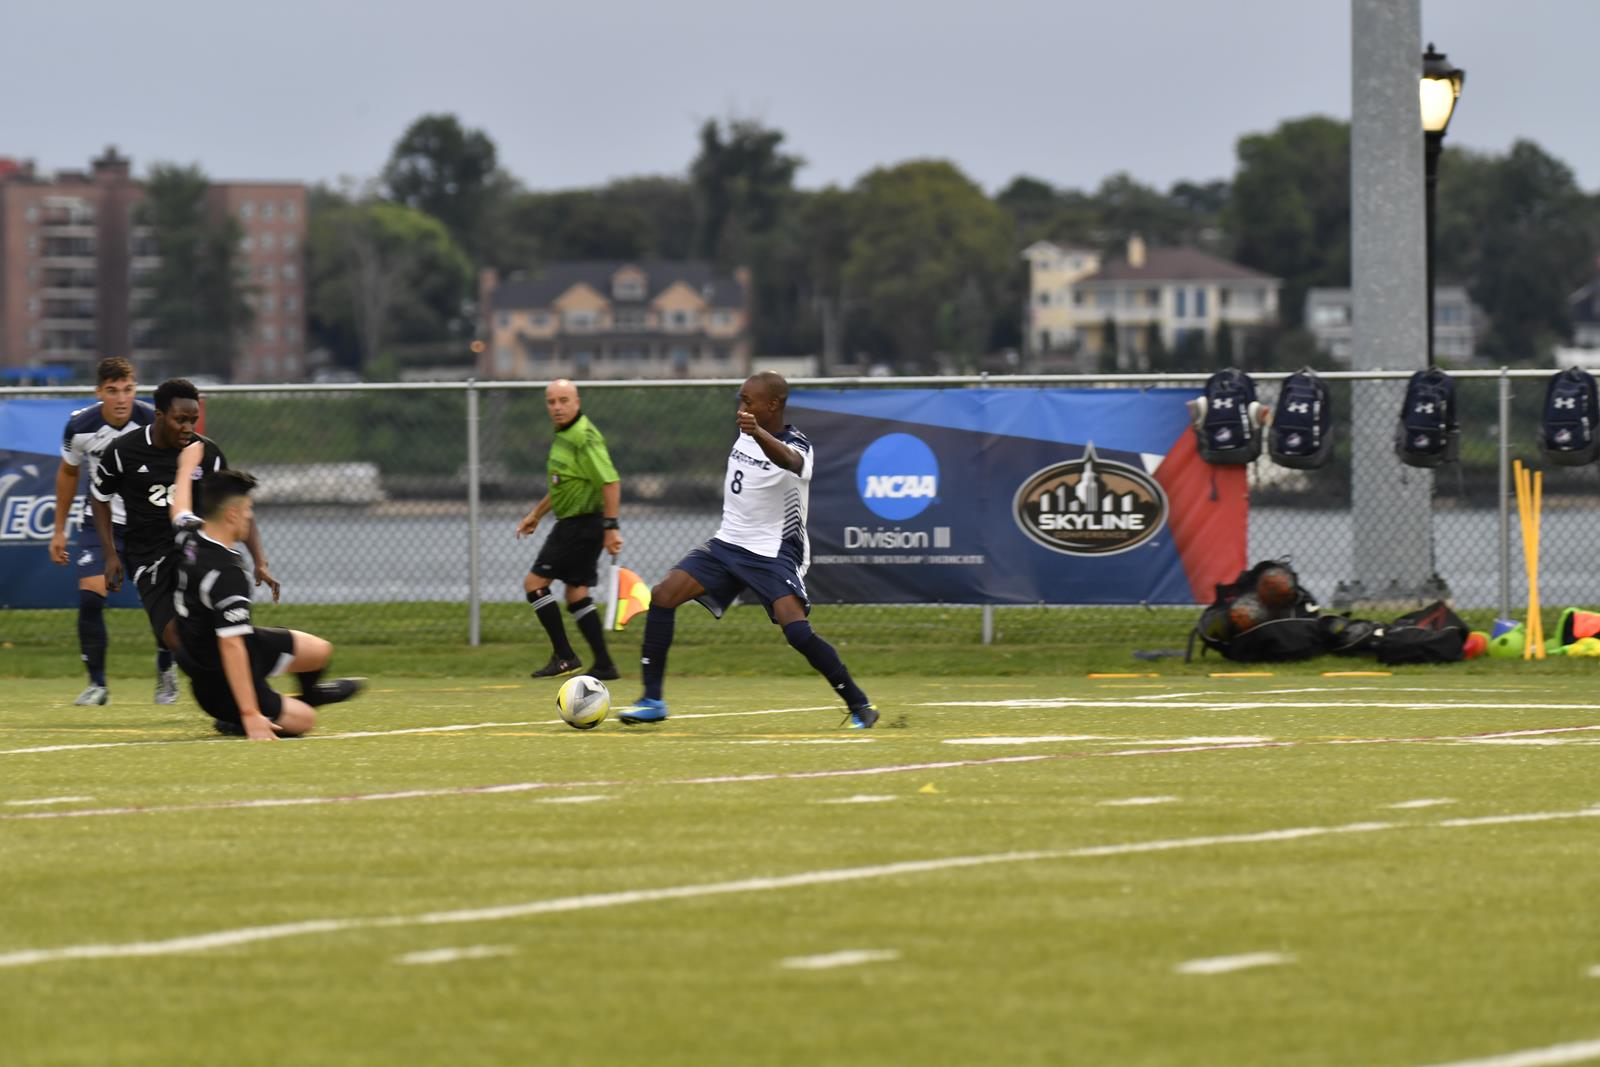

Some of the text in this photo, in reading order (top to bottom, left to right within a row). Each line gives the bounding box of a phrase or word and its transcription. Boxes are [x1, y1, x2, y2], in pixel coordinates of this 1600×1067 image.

[731, 470, 744, 494] 8
[864, 475, 937, 498] NCAA
[0, 495, 86, 540] ECF
[1038, 513, 1145, 530] SKYLINE
[844, 526, 929, 548] Division
